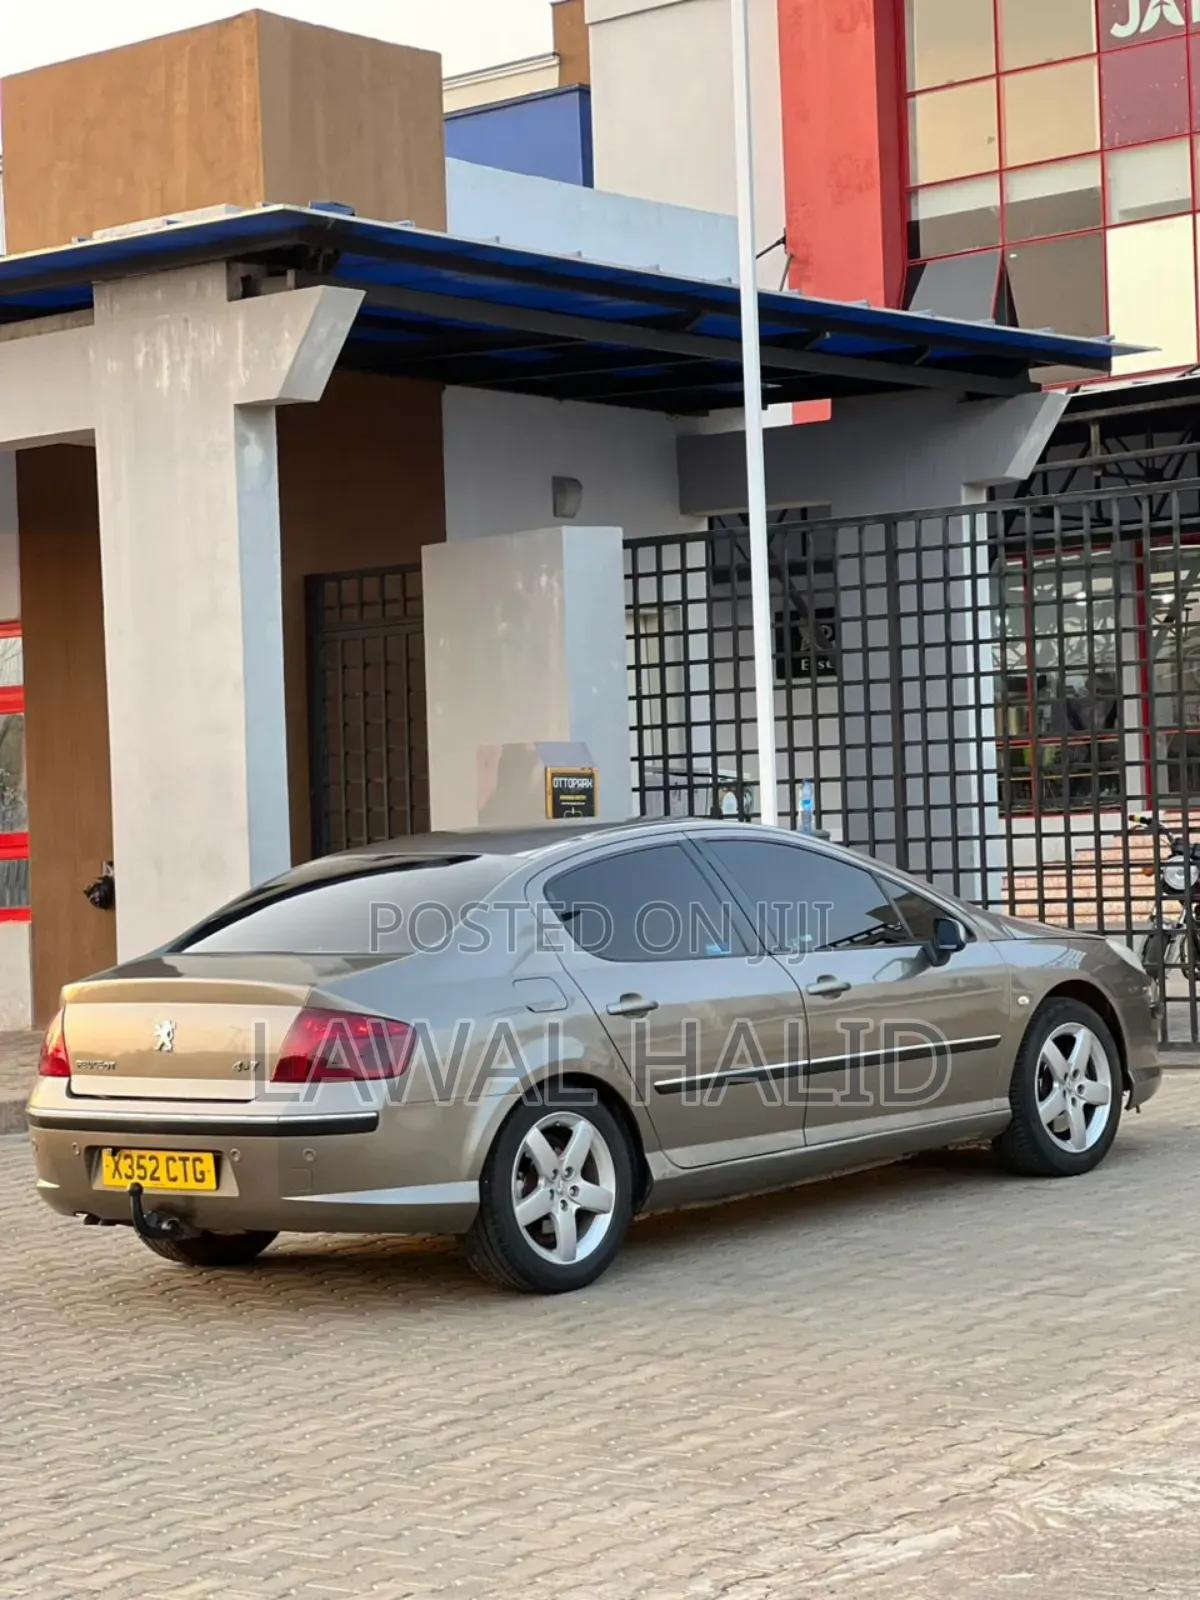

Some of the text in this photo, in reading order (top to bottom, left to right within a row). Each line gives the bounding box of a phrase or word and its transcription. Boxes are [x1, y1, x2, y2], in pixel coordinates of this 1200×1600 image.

[1110, 0, 1200, 37] JA
[111, 1153, 206, 1183] X352 CTG
